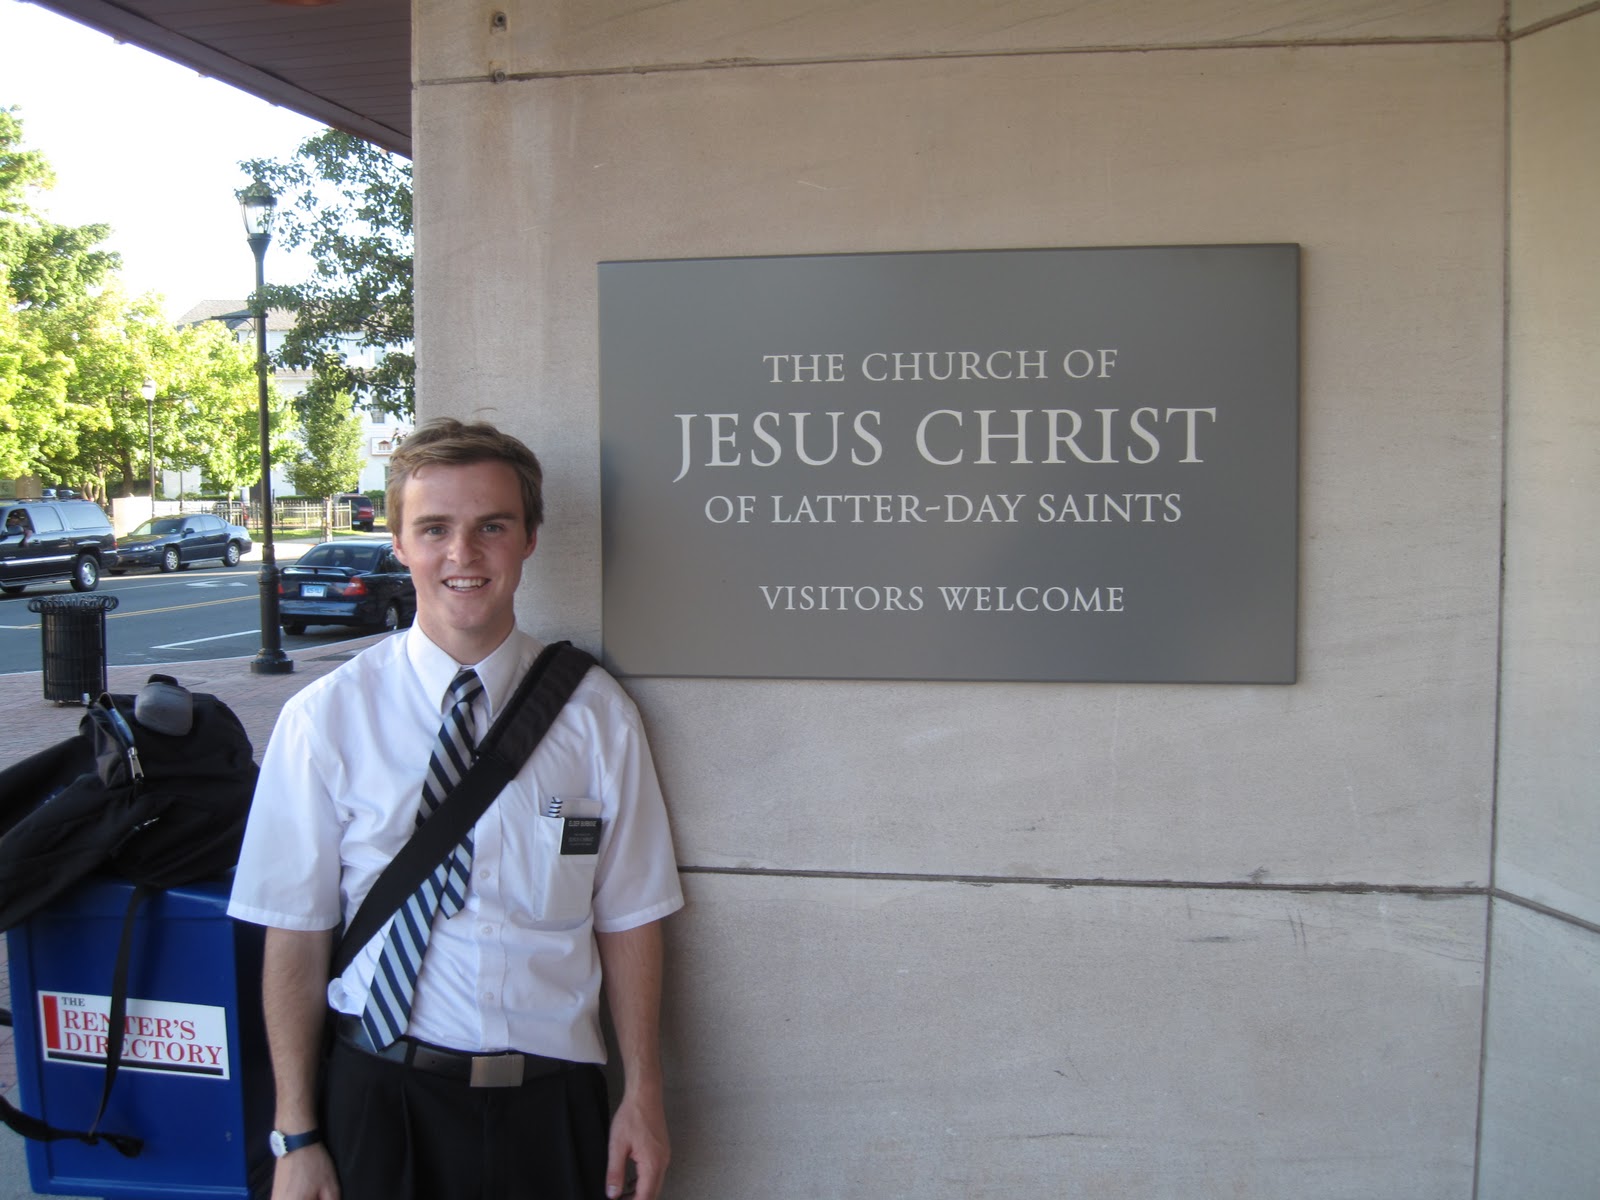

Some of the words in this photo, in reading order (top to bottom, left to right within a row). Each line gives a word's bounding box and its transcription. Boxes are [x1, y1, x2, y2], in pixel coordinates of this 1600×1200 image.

[762, 353, 845, 383] THE
[861, 350, 1049, 382] CHURCH
[1063, 349, 1118, 379] OF
[672, 409, 883, 483] JESUS
[915, 406, 1217, 466] CHRIST
[704, 495, 757, 524] OF
[770, 493, 1027, 524] LATTER-DAY
[1037, 493, 1182, 523] SAINTS
[758, 585, 924, 612] VISITORS
[937, 586, 1125, 612] WELCOME
[61, 996, 86, 1007] THE
